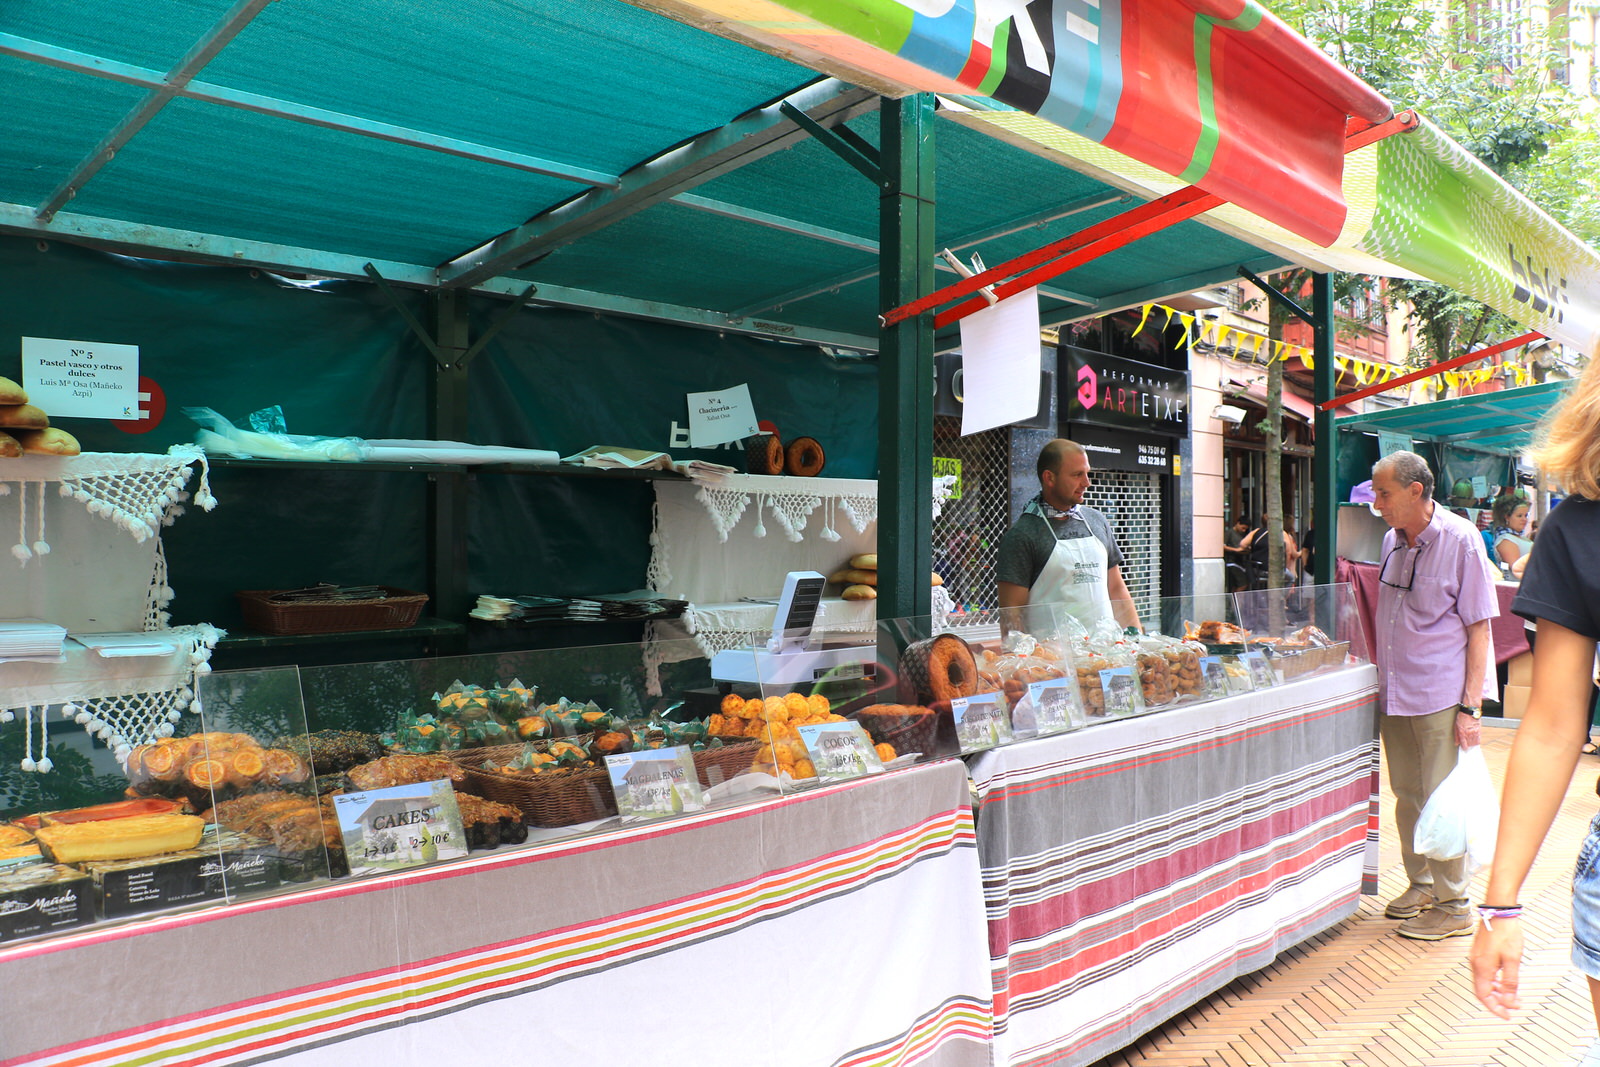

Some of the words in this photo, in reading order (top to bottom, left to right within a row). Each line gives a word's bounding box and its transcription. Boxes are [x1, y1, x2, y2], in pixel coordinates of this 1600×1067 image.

[71, 349, 84, 357] Nº
[87, 352, 93, 360] 5
[40, 359, 66, 367] Pastel
[100, 363, 123, 371] otros
[68, 370, 96, 378] dulces
[1103, 369, 1169, 390] REFORMAS
[72, 390, 93, 398] Azpi)
[1103, 386, 1183, 422] ARTETXE
[824, 736, 855, 749] COCOS
[626, 767, 684, 785] MAGDALENAS
[373, 808, 431, 830] CAKES
